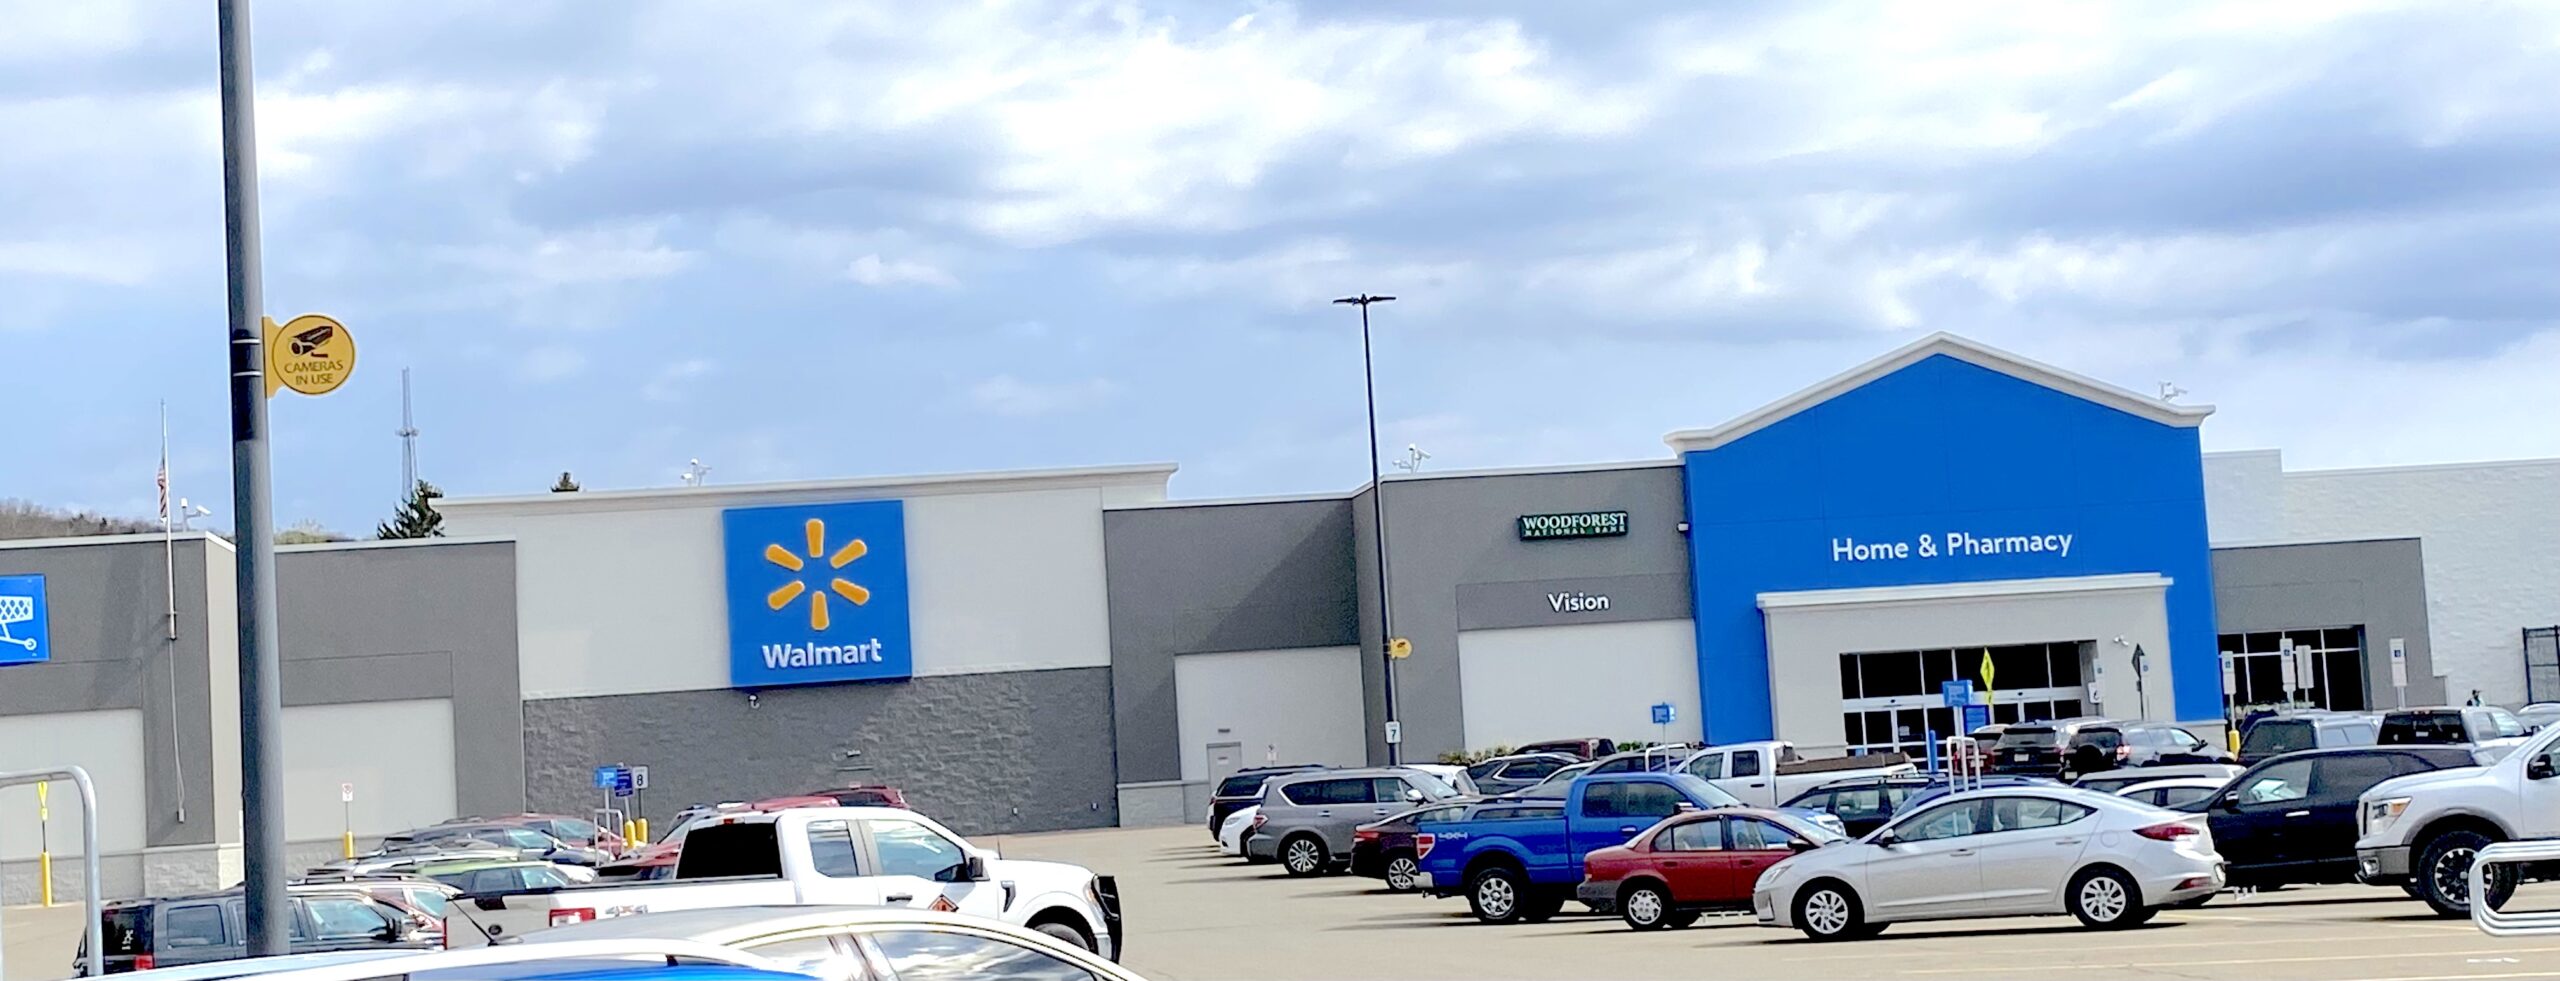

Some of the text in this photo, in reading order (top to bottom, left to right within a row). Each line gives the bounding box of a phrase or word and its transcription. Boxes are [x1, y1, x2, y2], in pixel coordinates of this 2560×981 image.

[284, 360, 344, 374] CAMERAS
[295, 373, 333, 385] IN USE
[1523, 513, 1627, 529] WOODFOREST
[1524, 525, 1626, 536] NATIONAL BANK
[1832, 532, 2073, 561] Home & Pharmacy
[1547, 592, 1610, 612] Vision
[762, 638, 882, 669] Walmart
[1391, 729, 1397, 740] 7
[636, 774, 643, 787] 8
